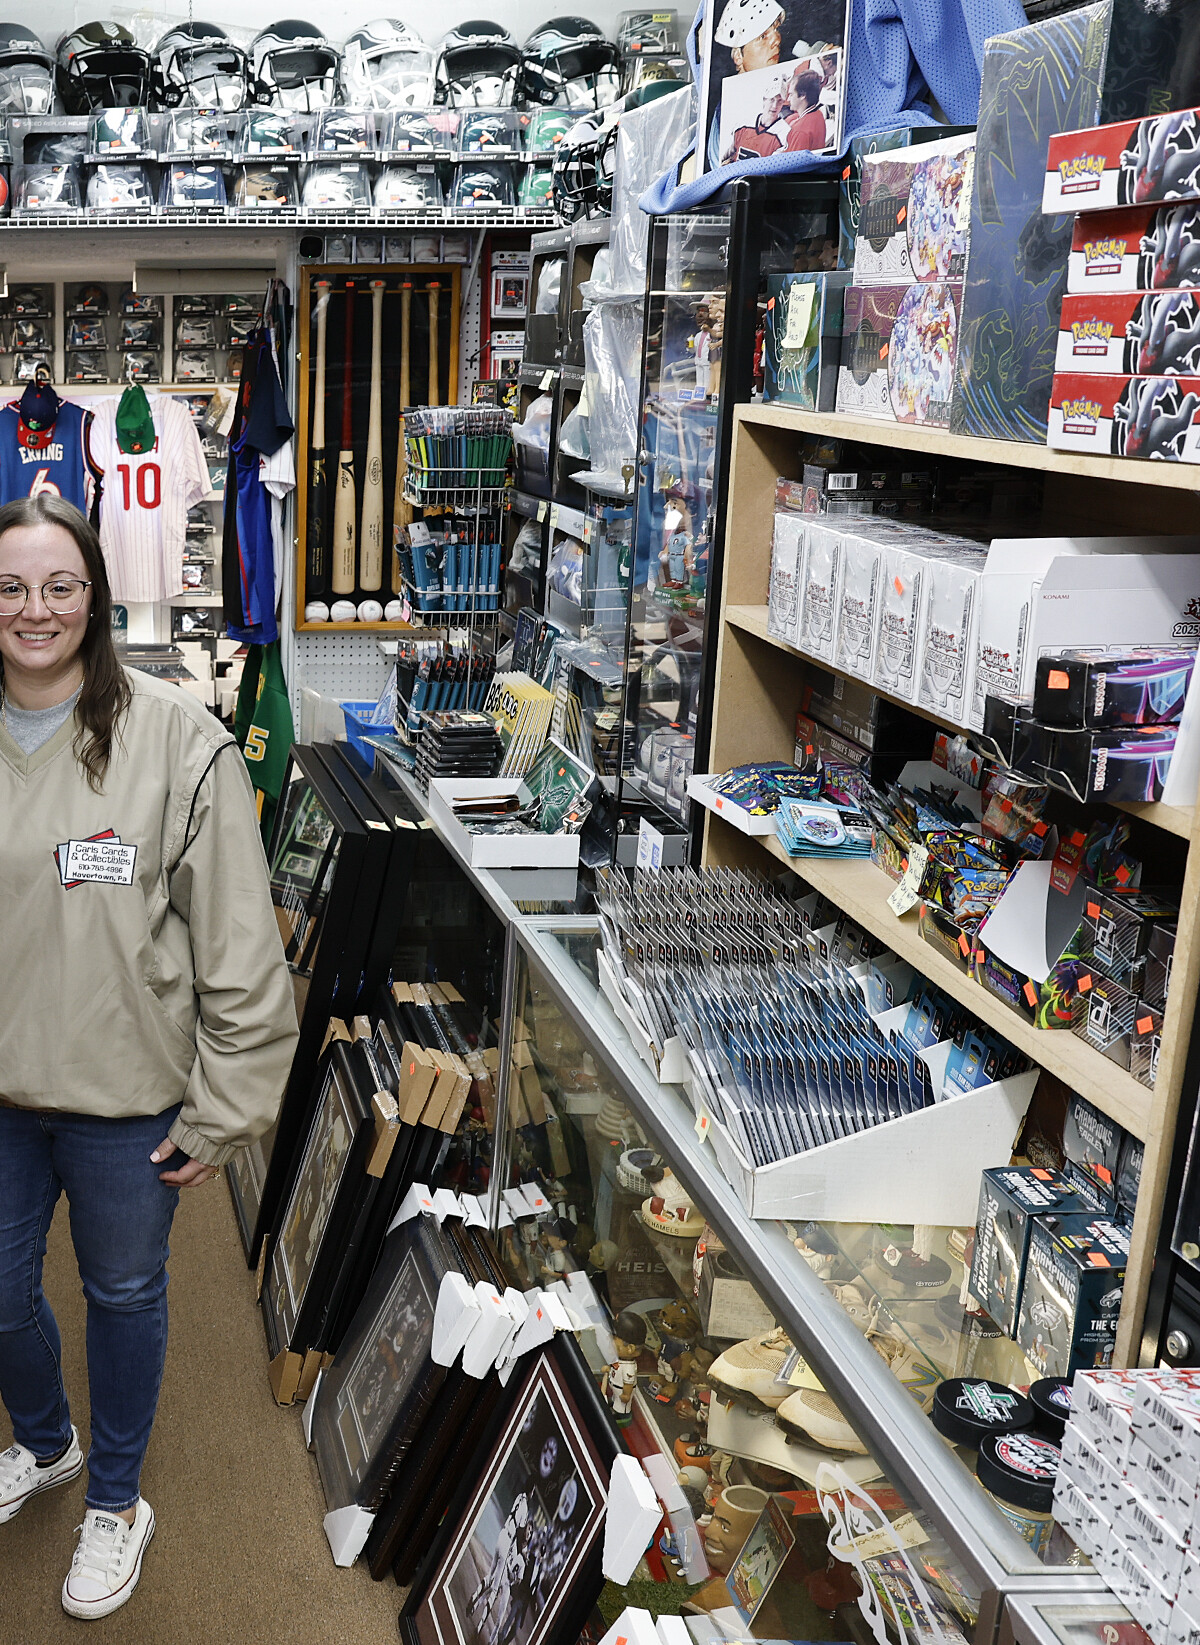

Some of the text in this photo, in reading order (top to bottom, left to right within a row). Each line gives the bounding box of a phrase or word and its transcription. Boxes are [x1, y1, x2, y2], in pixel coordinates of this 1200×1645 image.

[19, 444, 64, 464] ERVING
[117, 462, 161, 511] 10
[1176, 624, 1199, 636] 2025
[1094, 672, 1107, 717] KONAMI
[830, 738, 863, 763] TRAINER'S TOOLKIT
[1094, 748, 1108, 791] KONAMI
[71, 852, 131, 866] & Collectibles
[75, 844, 129, 857] Carls Cards
[72, 871, 116, 882] Havertown,
[1075, 1103, 1113, 1148] CHAMPIONS
[1079, 1125, 1104, 1154] EAGLES
[651, 1221, 680, 1235] HAMELS
[976, 1194, 1000, 1301] CHAMPIONS
[1034, 1234, 1051, 1253] SUPER
[618, 1261, 666, 1274] HEIS
[972, 1245, 982, 1286] SUPER
[1030, 1242, 1077, 1305] CHAMPIONS
[1091, 1320, 1108, 1331] THE
